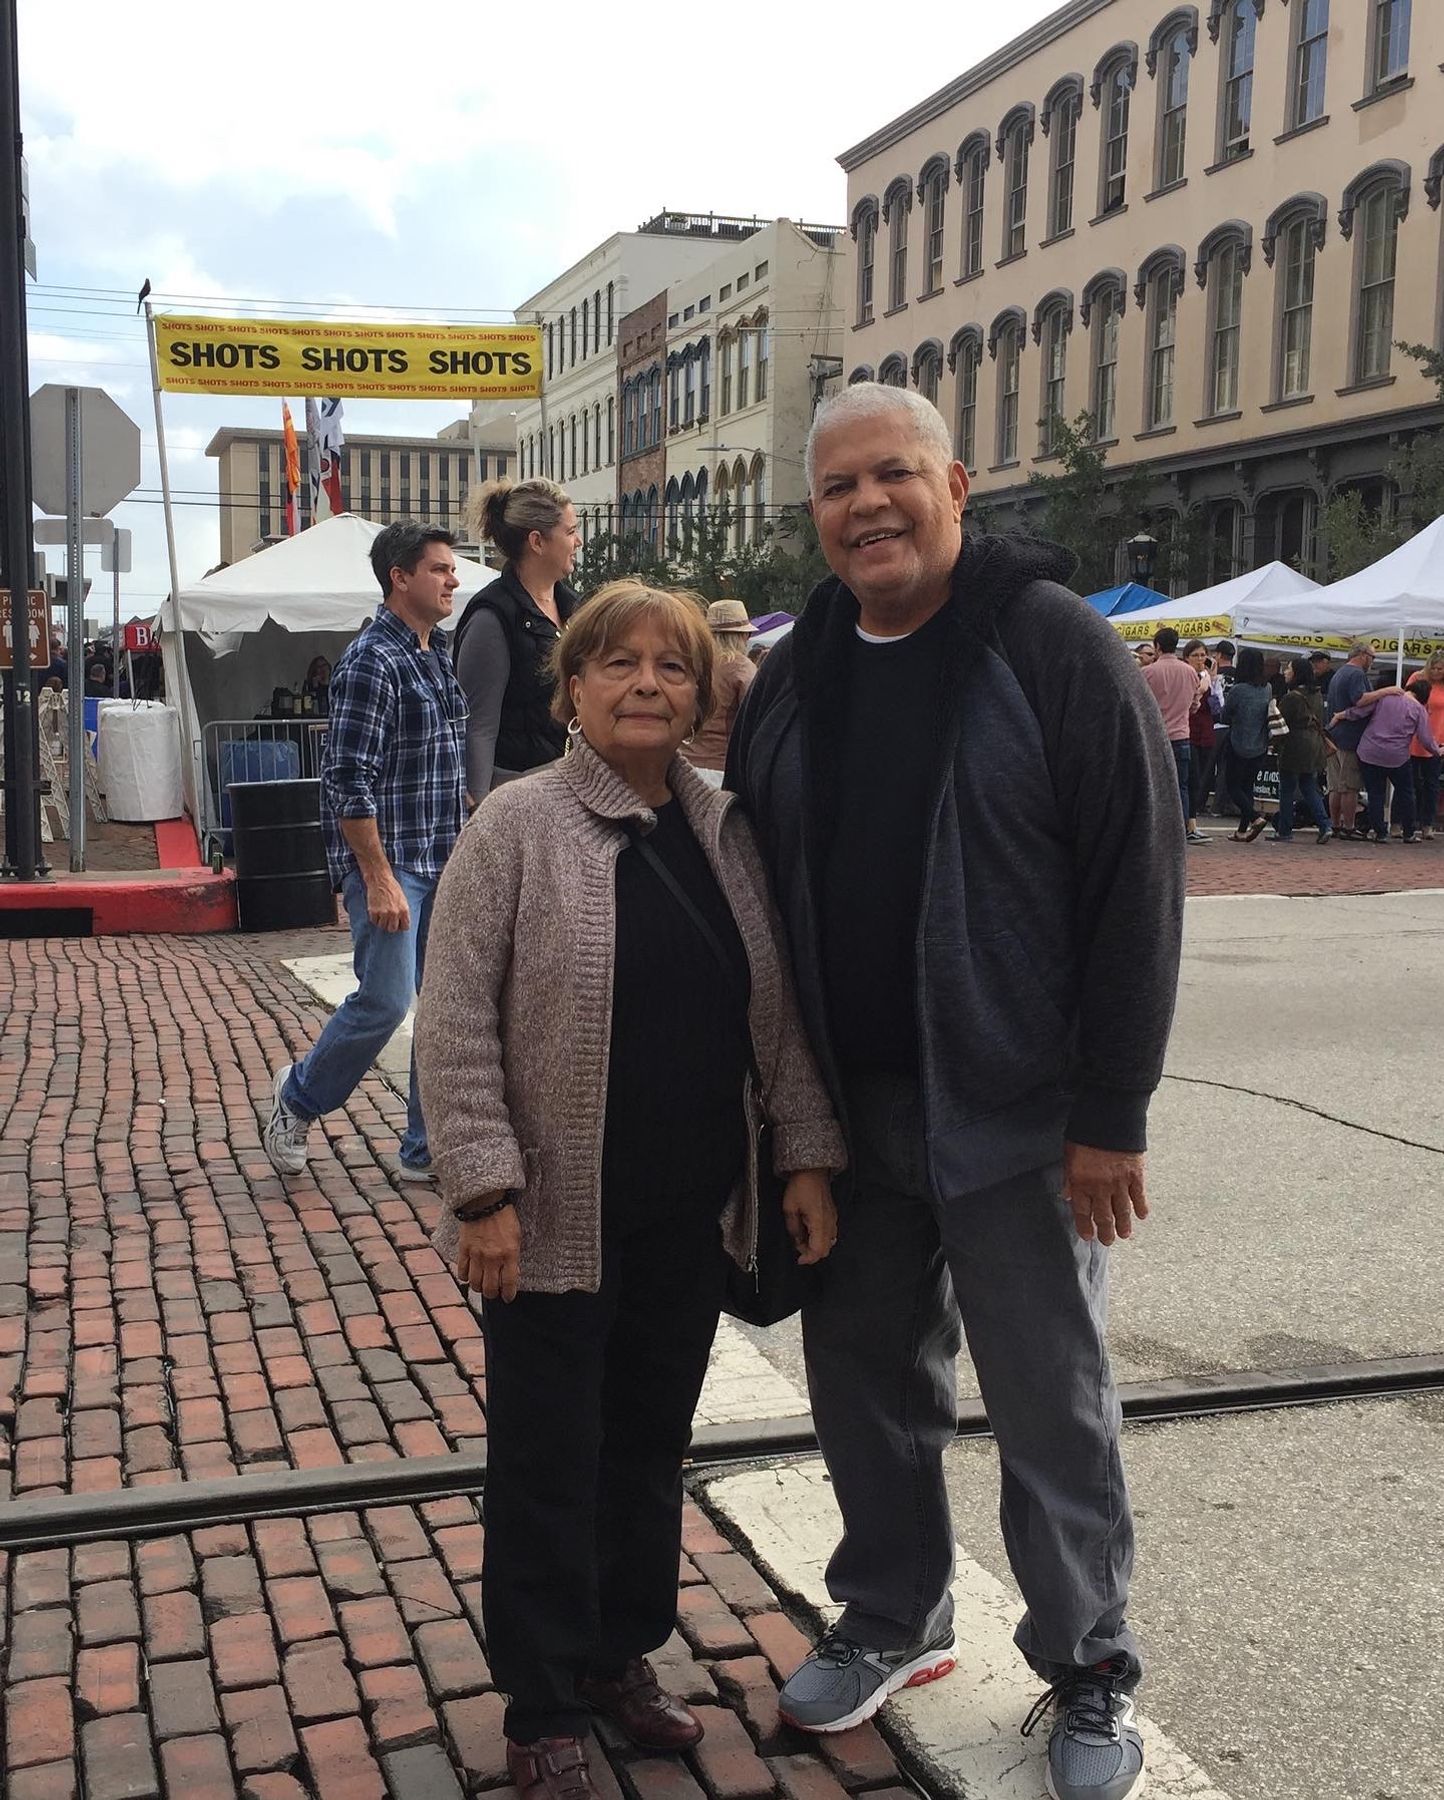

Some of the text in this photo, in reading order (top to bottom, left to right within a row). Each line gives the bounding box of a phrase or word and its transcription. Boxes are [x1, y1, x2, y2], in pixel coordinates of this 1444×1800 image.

[162, 322, 192, 331] SHOTS
[195, 323, 225, 332] SHOTS
[227, 325, 257, 334] SHOTS
[260, 327, 289, 335] SHOTS
[291, 328, 321, 336] SHOTS
[354, 330, 384, 338] SHOTS
[386, 331, 415, 339] SHOTS
[417, 332, 445, 340] SHOTS
[478, 333, 506, 341] SHOTS
[508, 334, 536, 342] SHOTS
[170, 341, 532, 376] SHOTS SHOTS SHOTS
[165, 377, 196, 385] SHOTS
[197, 378, 228, 386] SHOTS
[229, 379, 259, 387] SHOTS
[325, 382, 354, 390] SHOTS
[356, 383, 386, 391] SHOTS
[387, 384, 417, 392] SHOTS
[450, 385, 478, 393] SHOTS
[509, 385, 536, 393] SHOTS
[1174, 621, 1211, 635] CIGARS
[1370, 638, 1432, 655] CIGARS
